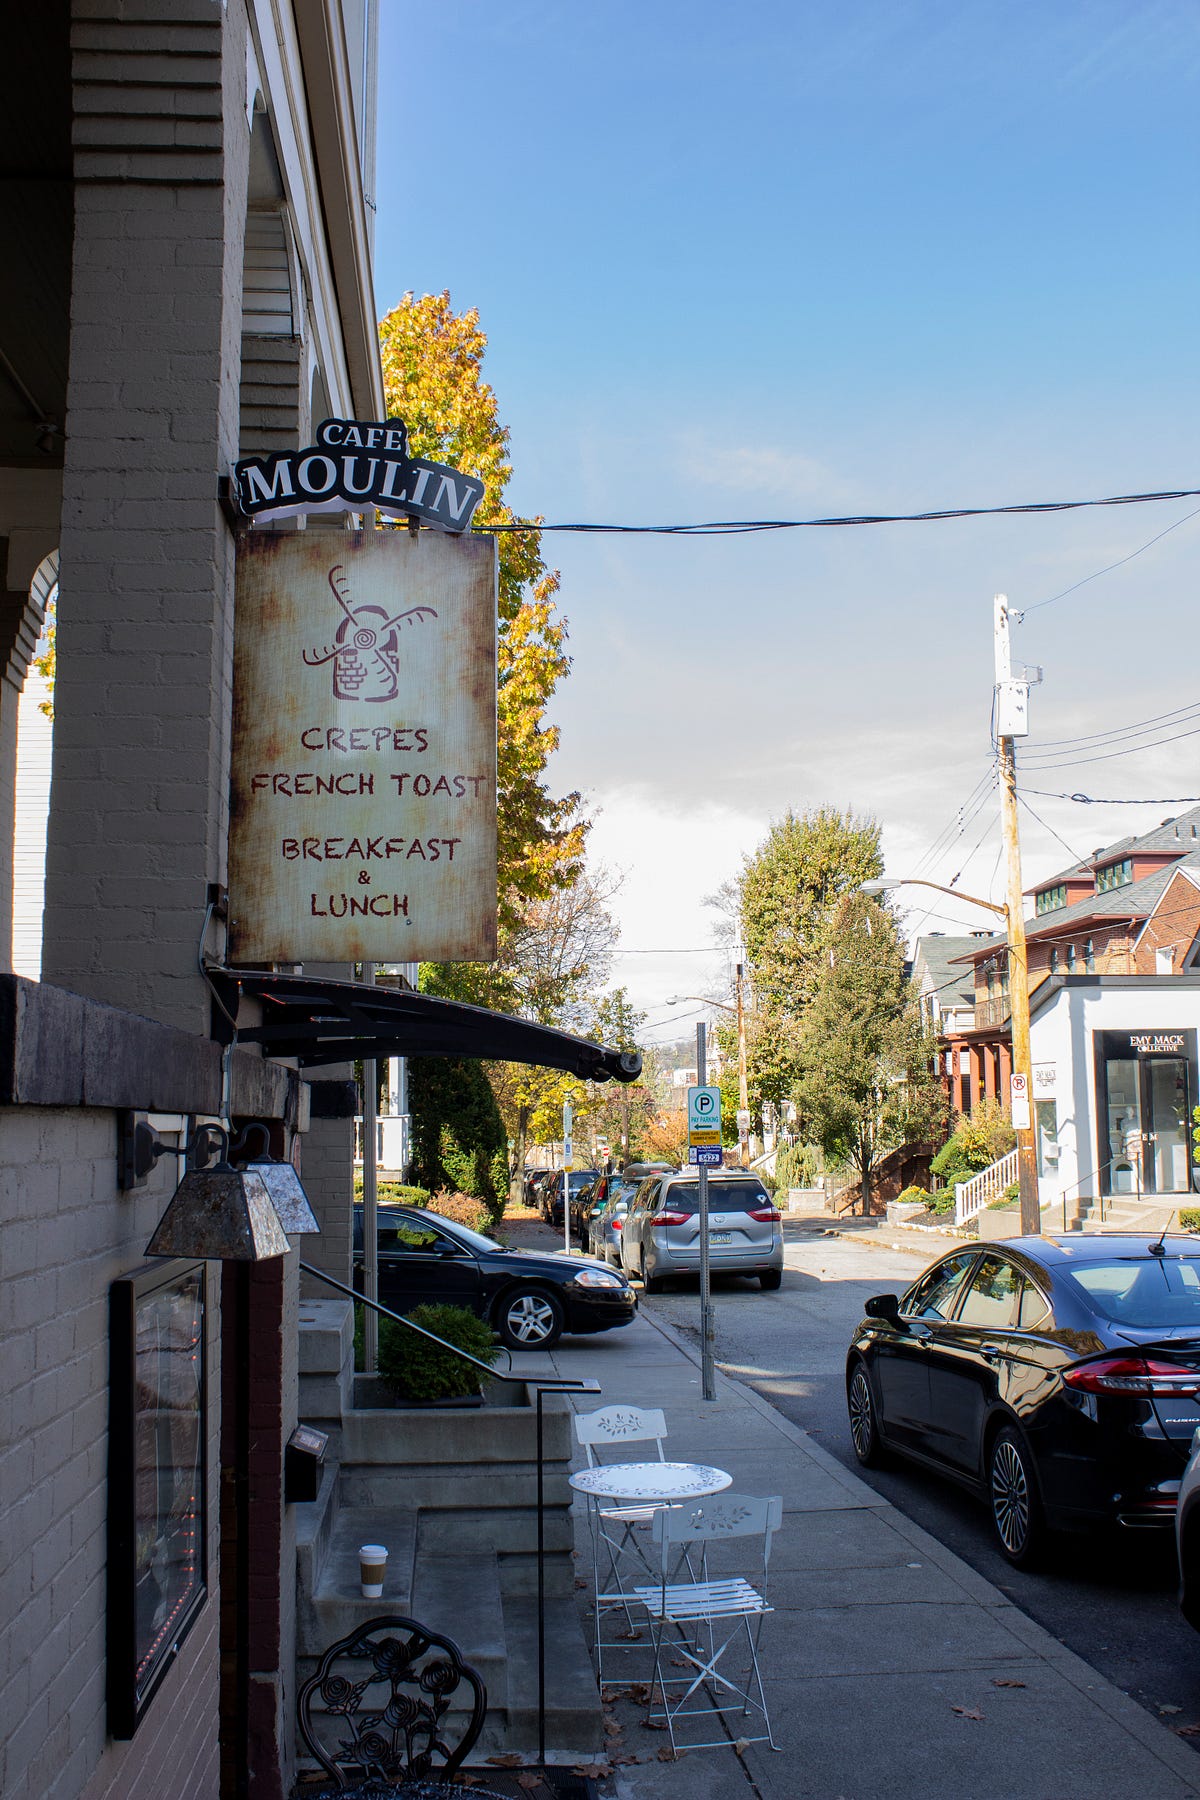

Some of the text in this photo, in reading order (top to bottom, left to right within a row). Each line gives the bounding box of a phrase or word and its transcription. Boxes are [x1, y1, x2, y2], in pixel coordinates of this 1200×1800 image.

[241, 455, 477, 521] MOULIN
[301, 727, 429, 753] CREPES
[251, 773, 487, 798] FRENCH TOAST
[281, 836, 462, 862] BREAKFAST
[357, 870, 371, 885] &
[310, 893, 409, 918] LUNCH
[1130, 1035, 1184, 1045] EMY MACK
[700, 1097, 710, 1111] P
